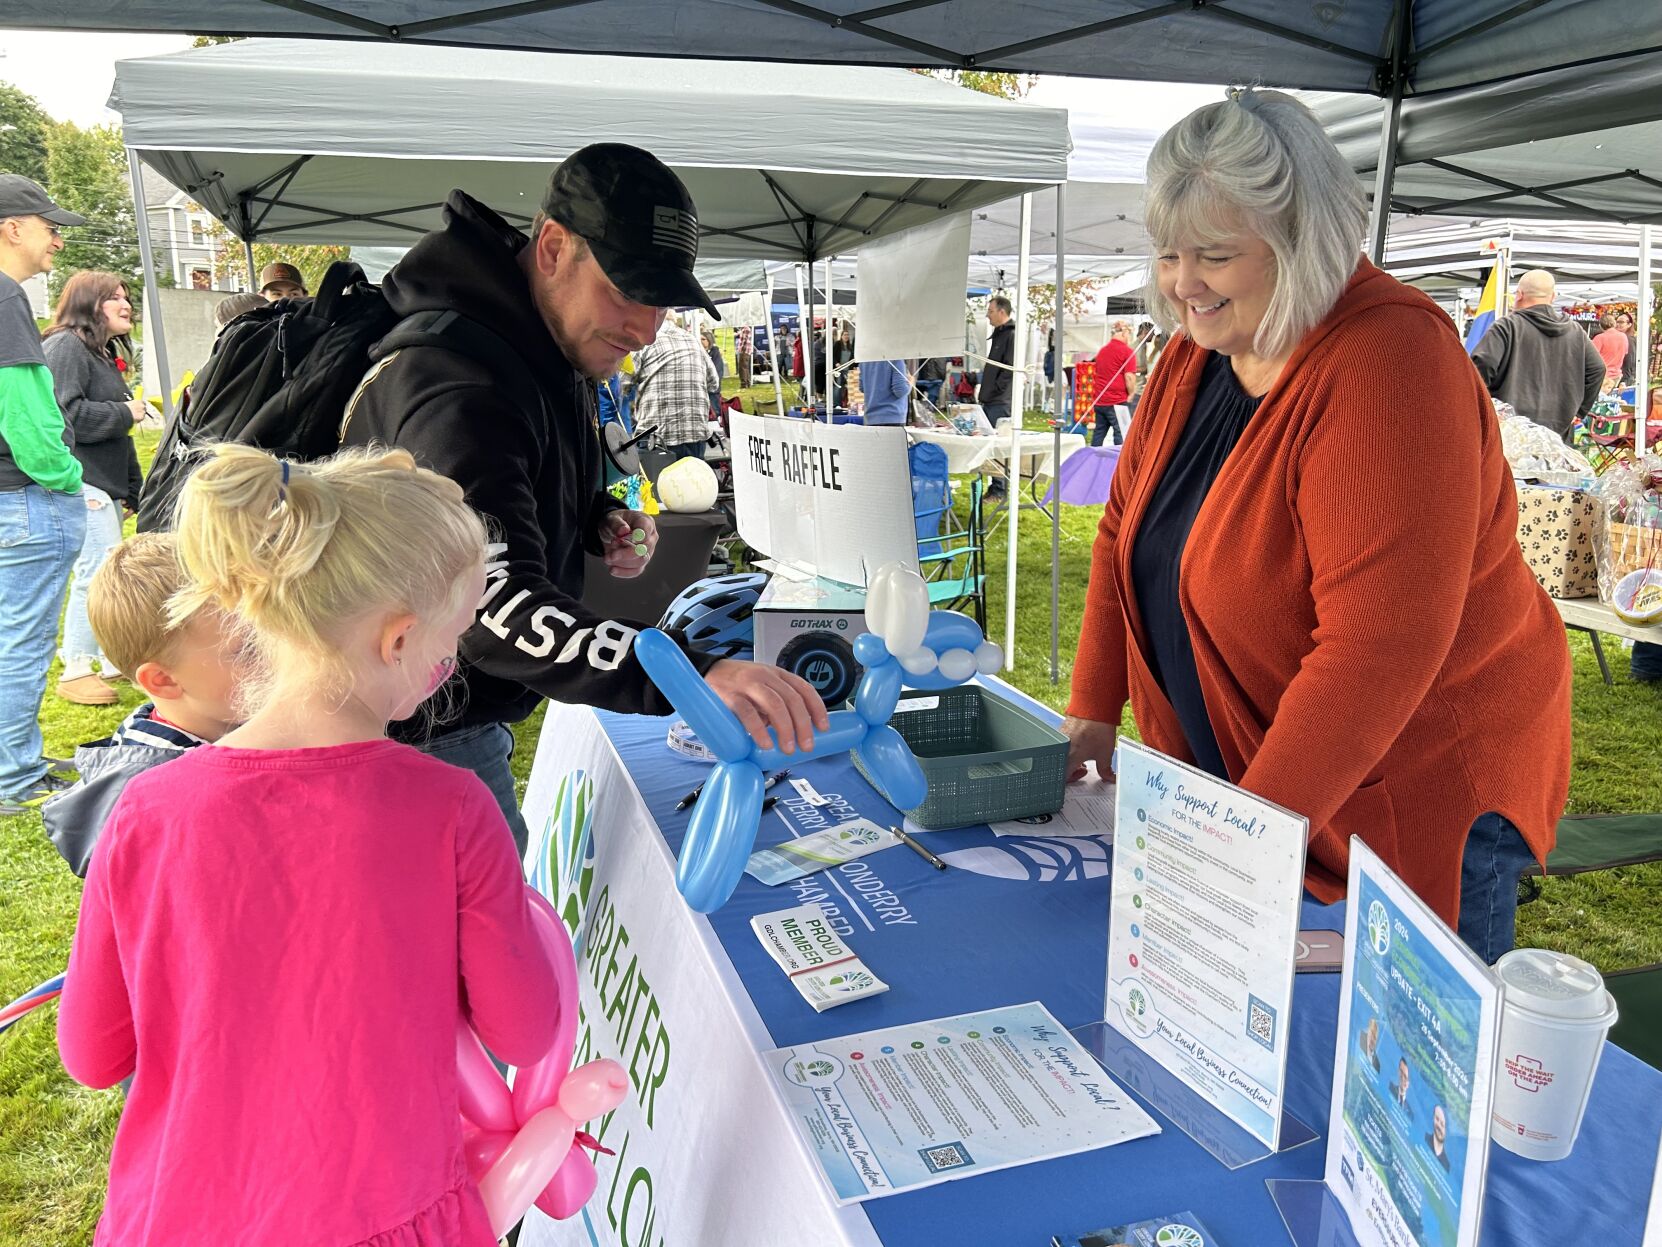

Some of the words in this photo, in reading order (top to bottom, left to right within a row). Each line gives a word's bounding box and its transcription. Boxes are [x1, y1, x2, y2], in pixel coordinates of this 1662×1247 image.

[748, 435, 774, 478] FREE
[782, 442, 842, 491] RAFFLE
[790, 619, 833, 629] GOTRAX
[821, 794, 860, 824] GREA
[1146, 771, 1169, 800] Why
[1174, 785, 1218, 818] Support
[782, 798, 832, 829] DERRY
[1148, 814, 1172, 834] Economic
[1172, 809, 1188, 823] FOR
[1188, 816, 1201, 830] THE
[1202, 823, 1232, 844] IMPACT!
[1147, 843, 1175, 865] Community
[780, 918, 824, 965] MEMBER
[806, 919, 843, 956] PROUD
[1394, 918, 1409, 941] 2024
[586, 884, 670, 1131] GREATER
[1390, 964, 1413, 1000] UPDATE
[1417, 996, 1431, 1020] EXIT
[1432, 1016, 1440, 1034] 4A
[1030, 1025, 1057, 1042] Why
[1049, 1046, 1090, 1077] Support
[1156, 1018, 1175, 1039] Your
[1175, 1033, 1196, 1055] Local
[1197, 1048, 1227, 1078] Business
[1228, 1072, 1273, 1109] Connection!
[1032, 1048, 1045, 1061] FOR
[1043, 1060, 1056, 1072] THE
[1051, 1071, 1075, 1094] IMPACT!
[1505, 1064, 1526, 1075] ORDER
[1528, 1074, 1552, 1082] AHEAD
[815, 1086, 831, 1102] Your
[827, 1104, 849, 1121] Local
[837, 1122, 858, 1149] Business
[853, 1151, 885, 1187] Connection!
